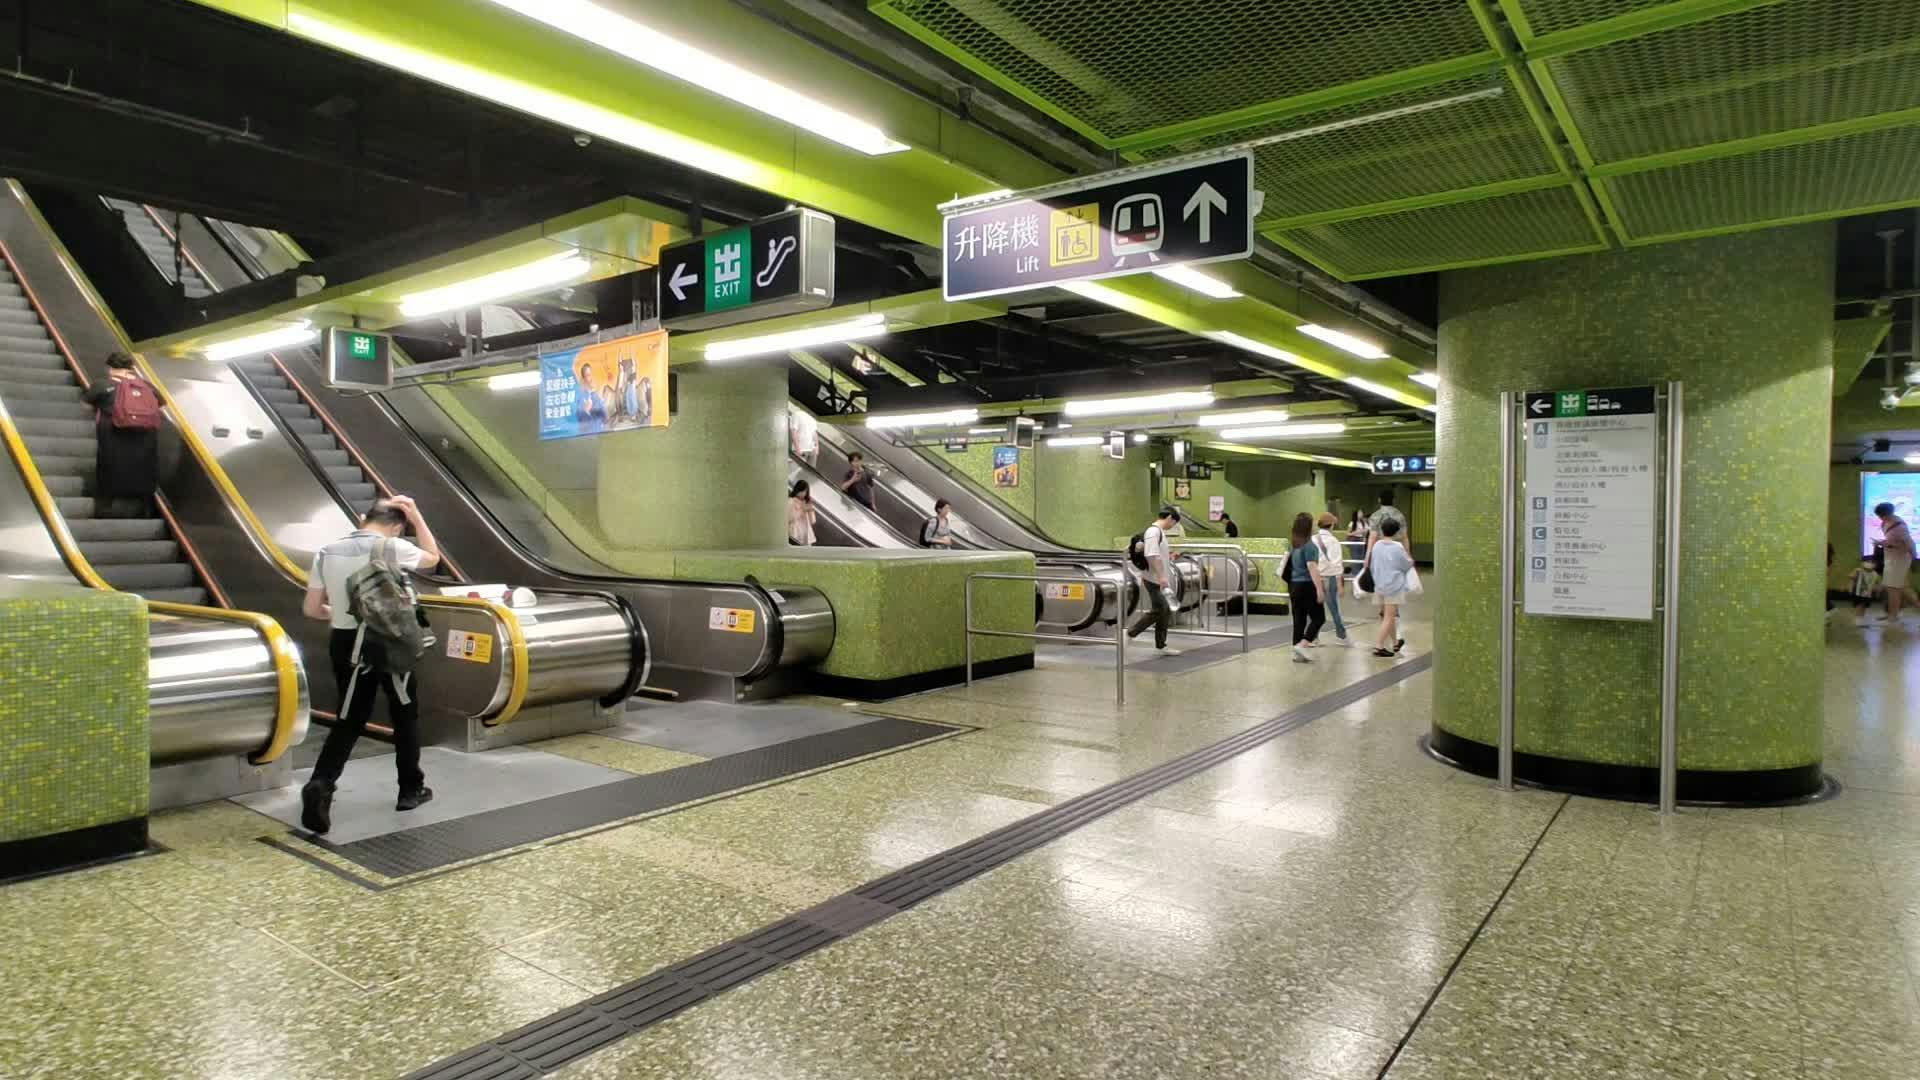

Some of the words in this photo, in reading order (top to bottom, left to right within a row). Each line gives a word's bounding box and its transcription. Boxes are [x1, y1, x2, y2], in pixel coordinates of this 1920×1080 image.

[954, 214, 1040, 262] 升降機
[715, 243, 741, 284] 出
[1016, 255, 1040, 274] Lift
[714, 280, 741, 298] EXIT
[354, 336, 370, 349] 出
[1562, 393, 1580, 409] 出
[1536, 423, 1545, 434] A
[1535, 498, 1544, 508] B
[1535, 528, 1544, 538] C
[1534, 558, 1544, 568] D
